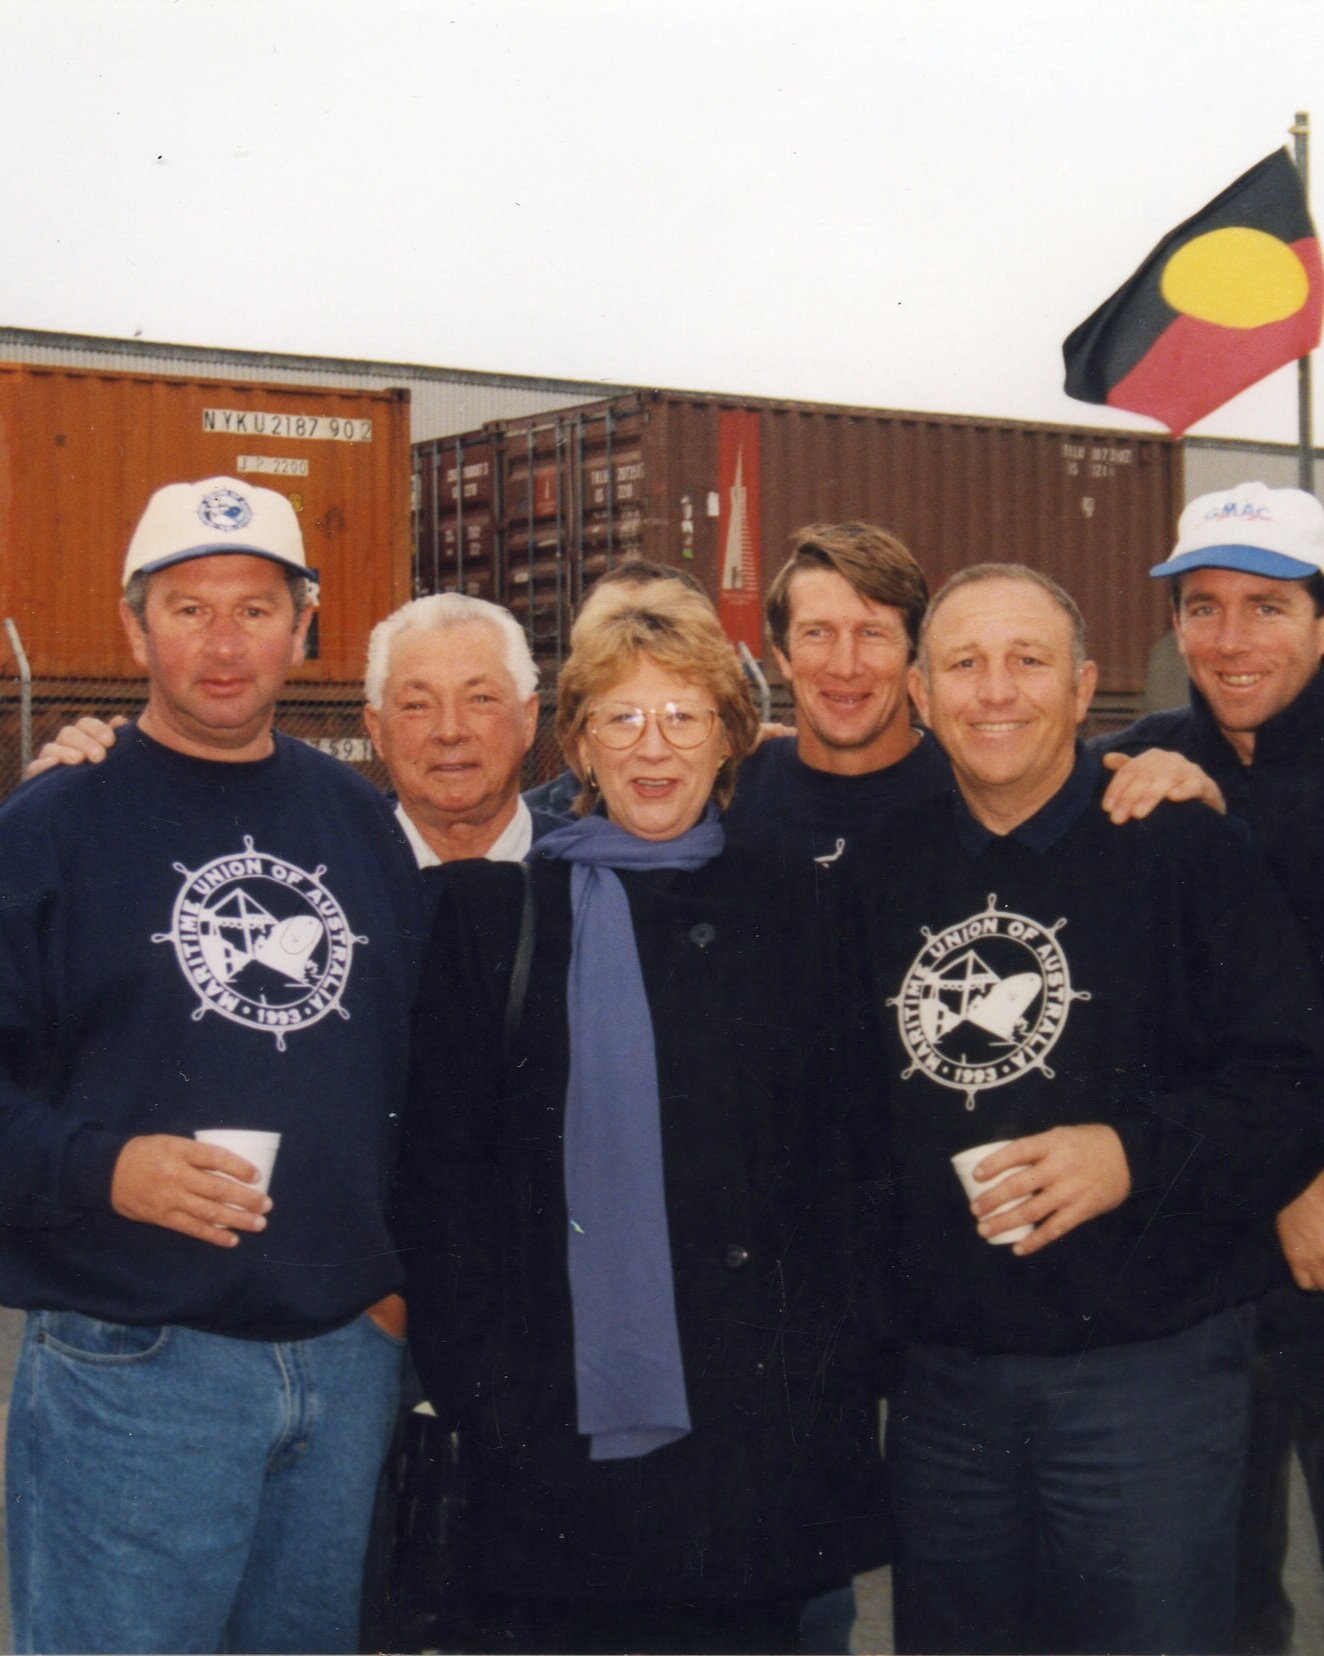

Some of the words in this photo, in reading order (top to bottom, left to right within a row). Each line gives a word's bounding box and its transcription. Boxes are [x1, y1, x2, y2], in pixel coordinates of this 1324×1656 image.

[273, 459, 307, 475] 2200
[192, 858, 263, 895] UNION
[271, 864, 304, 885] OF
[928, 917, 999, 960] UNION
[1007, 921, 1040, 942] OF
[179, 899, 240, 1013] MARITIME
[307, 889, 348, 1012] AUSTRALIA
[257, 1007, 302, 1025] 1993
[904, 963, 942, 1071] MARITIME
[1010, 943, 1065, 1069] AUSTRALIA
[953, 1067, 999, 1085] 1993
